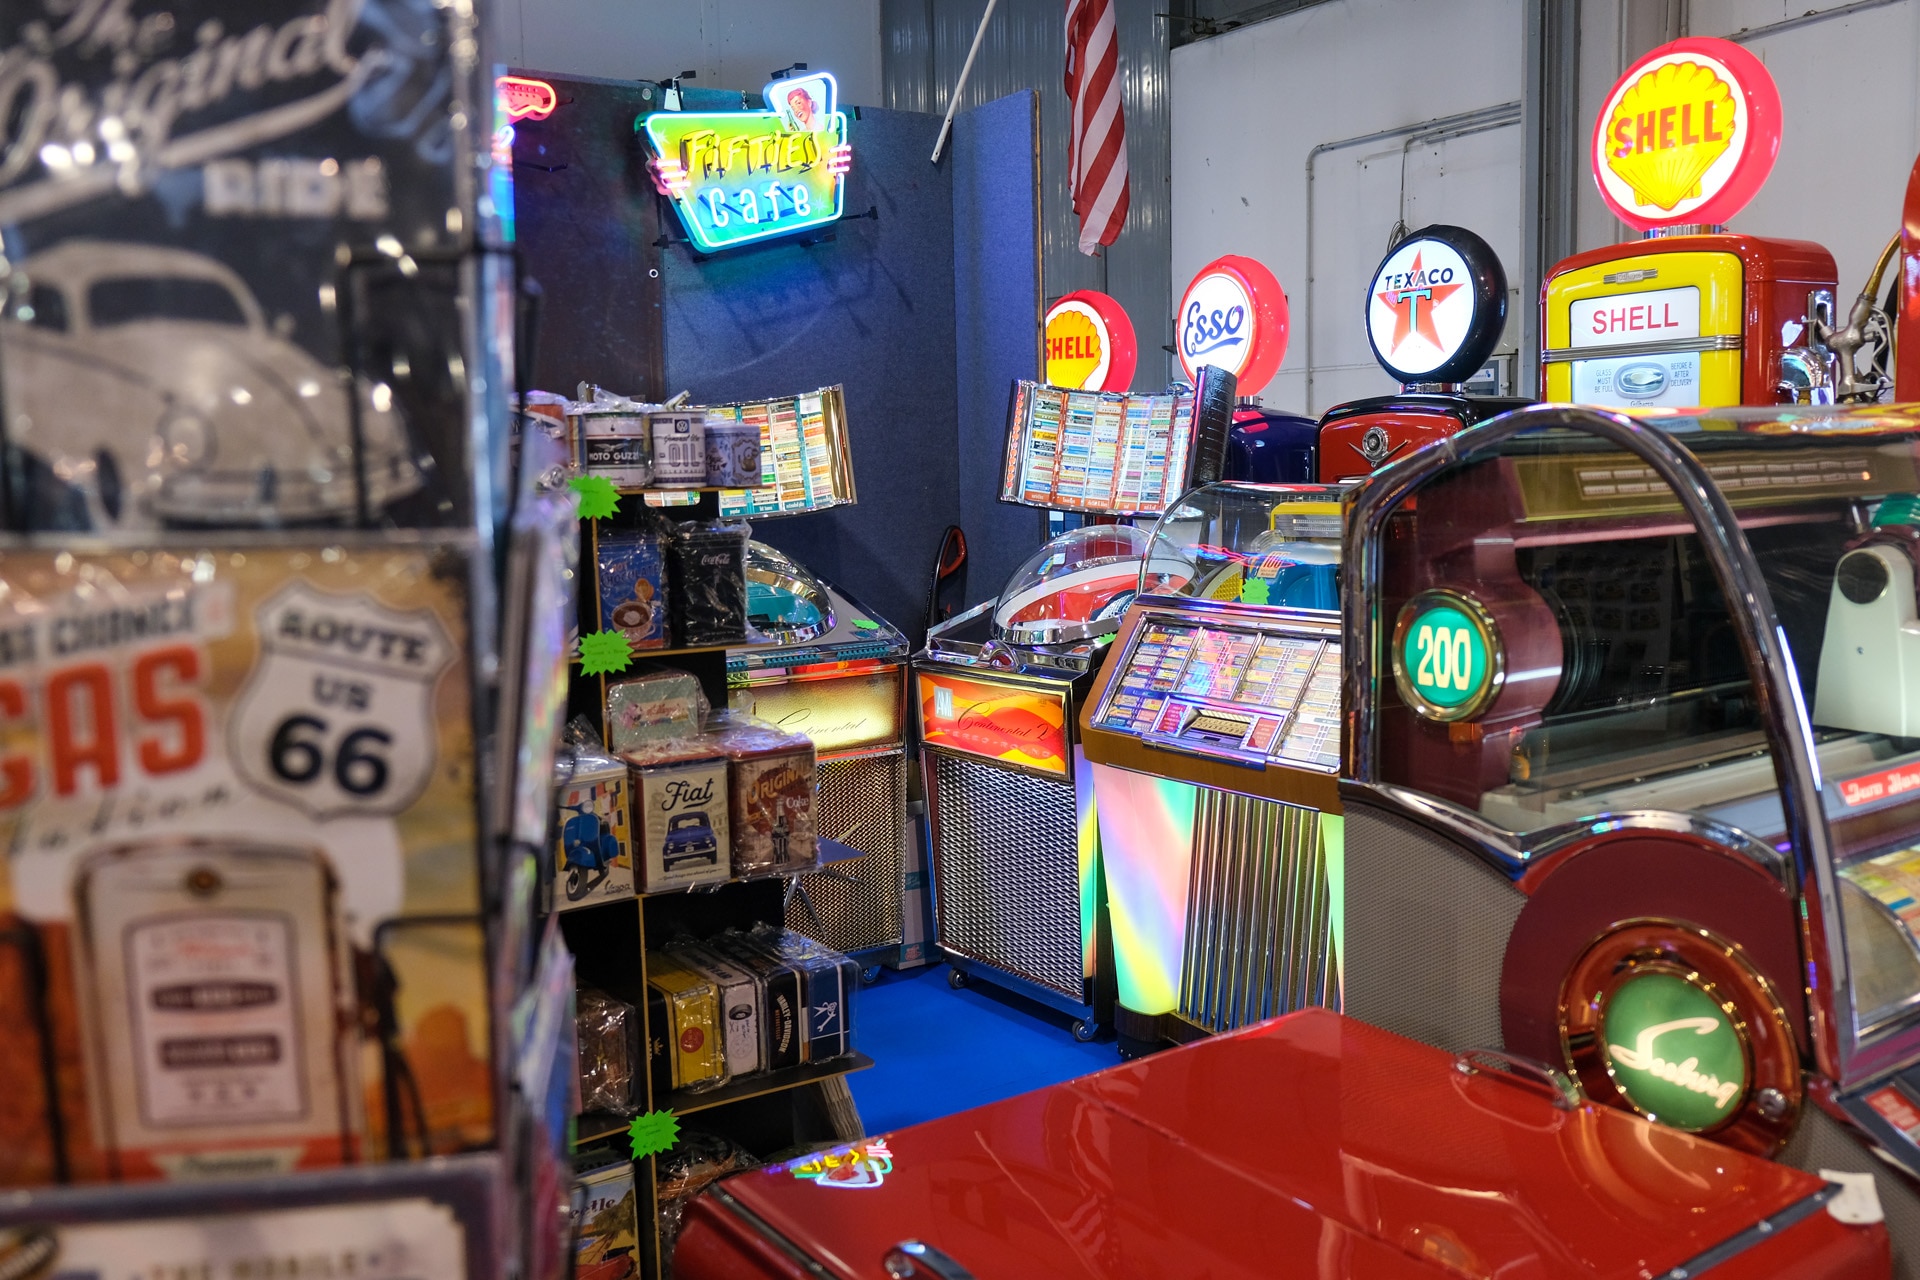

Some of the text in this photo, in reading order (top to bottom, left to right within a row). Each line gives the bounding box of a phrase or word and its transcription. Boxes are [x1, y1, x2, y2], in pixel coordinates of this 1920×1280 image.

[1612, 100, 1724, 159] SHELL
[1384, 267, 1454, 291] TEXACO
[1183, 300, 1245, 358] Esso
[1592, 303, 1679, 334] SHELL
[1046, 335, 1095, 361] SHELL
[1596, 369, 1612, 377] GLASS
[1597, 377, 1611, 385] MUST
[1670, 379, 1692, 387] DELIVERY
[1674, 370, 1689, 378] AFTER
[1602, 385, 1613, 393] FULL
[589, 452, 610, 460] MOTO
[668, 443, 700, 467] OIL
[279, 607, 429, 665] ROUTE
[1417, 625, 1471, 691] 200
[312, 674, 373, 712] US
[957, 702, 1049, 741] Continental 2
[267, 714, 393, 797] 66
[661, 778, 714, 811] Fiat
[747, 765, 805, 804] ORIGIN
[786, 795, 809, 808] Coke
[776, 994, 792, 1053] HARLEY-DAVIDSON
[570, 1198, 615, 1219] eetle
